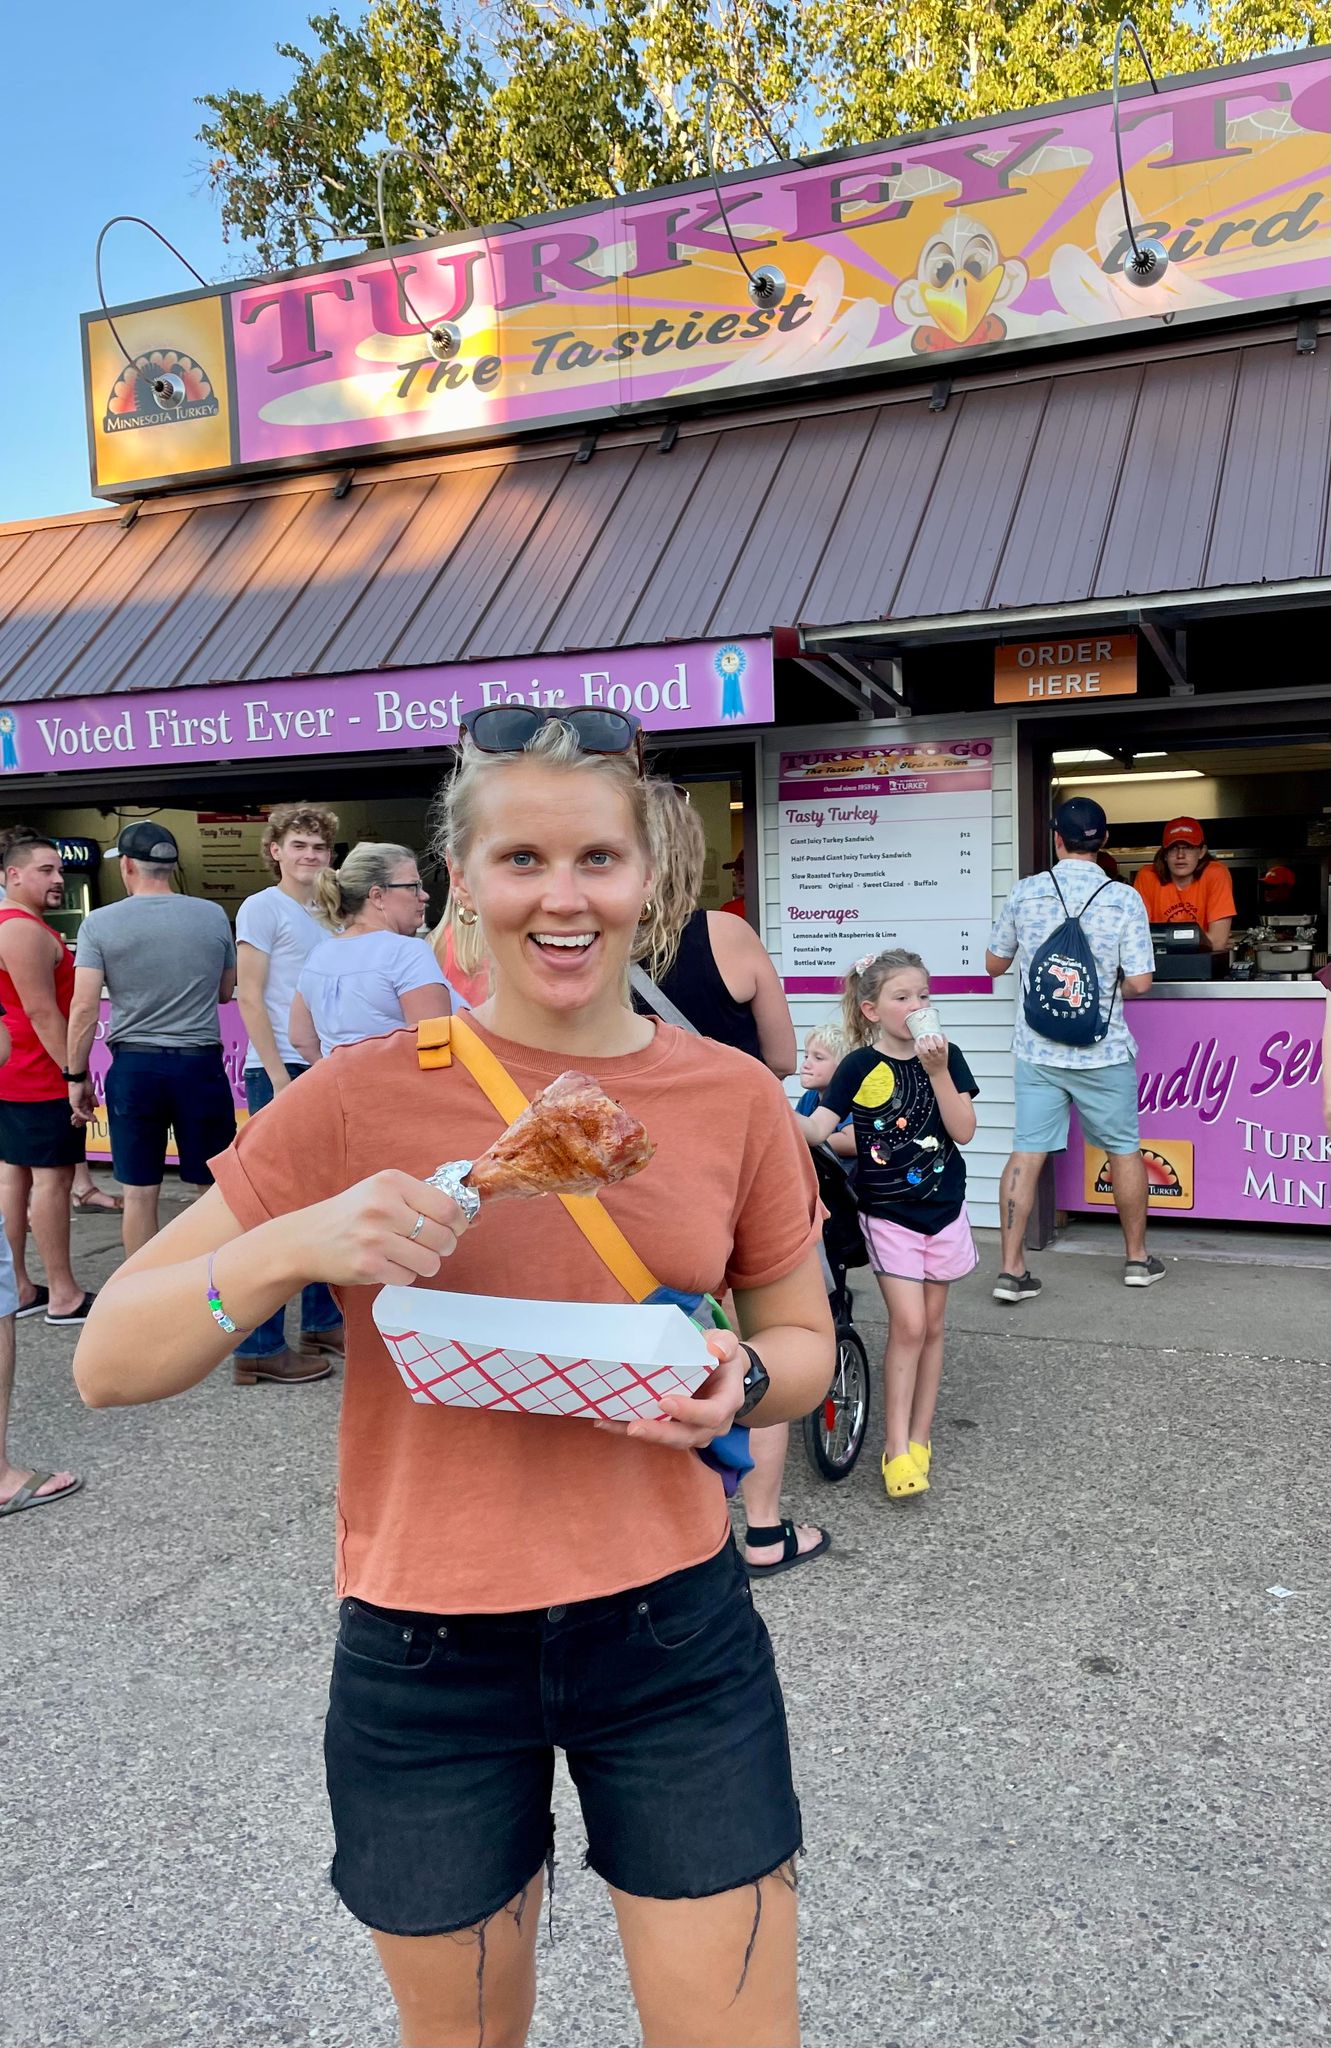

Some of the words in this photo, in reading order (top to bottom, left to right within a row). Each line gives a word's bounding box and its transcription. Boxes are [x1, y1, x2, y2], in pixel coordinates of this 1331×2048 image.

[240, 127, 1063, 374] TURKEY
[397, 355, 502, 398] The
[531, 292, 813, 376] Tastiest
[107, 413, 172, 431] MINNESOTA
[1017, 640, 1113, 667] ORDER
[1028, 672, 1101, 697] HERE
[36, 711, 136, 756] Voted
[145, 708, 233, 749] First
[244, 701, 335, 743] Ever
[374, 690, 464, 733] Best
[580, 663, 692, 713] Food
[783, 748, 896, 769] TURKEY
[949, 742, 992, 756] GO
[900, 761, 924, 769] Bird
[943, 759, 969, 767] Town
[897, 781, 928, 790] TURKEY
[785, 808, 825, 827] Tasty
[828, 805, 879, 825] Turkey
[807, 837, 822, 845] Juicy
[57, 842, 89, 861] ANI
[791, 854, 825, 862] Half-Pound
[843, 853, 858, 861] Juicy
[859, 852, 880, 860] Turkey
[881, 851, 912, 859] Sandwich
[854, 869, 885, 877] Drumstick
[787, 906, 859, 925] Beverages
[838, 931, 874, 939] Raspberries
[793, 945, 820, 953] Fountain
[1138, 1037, 1238, 1124] udly
[1149, 1185, 1179, 1196] TURKEY
[1242, 1165, 1331, 1209] MIN
